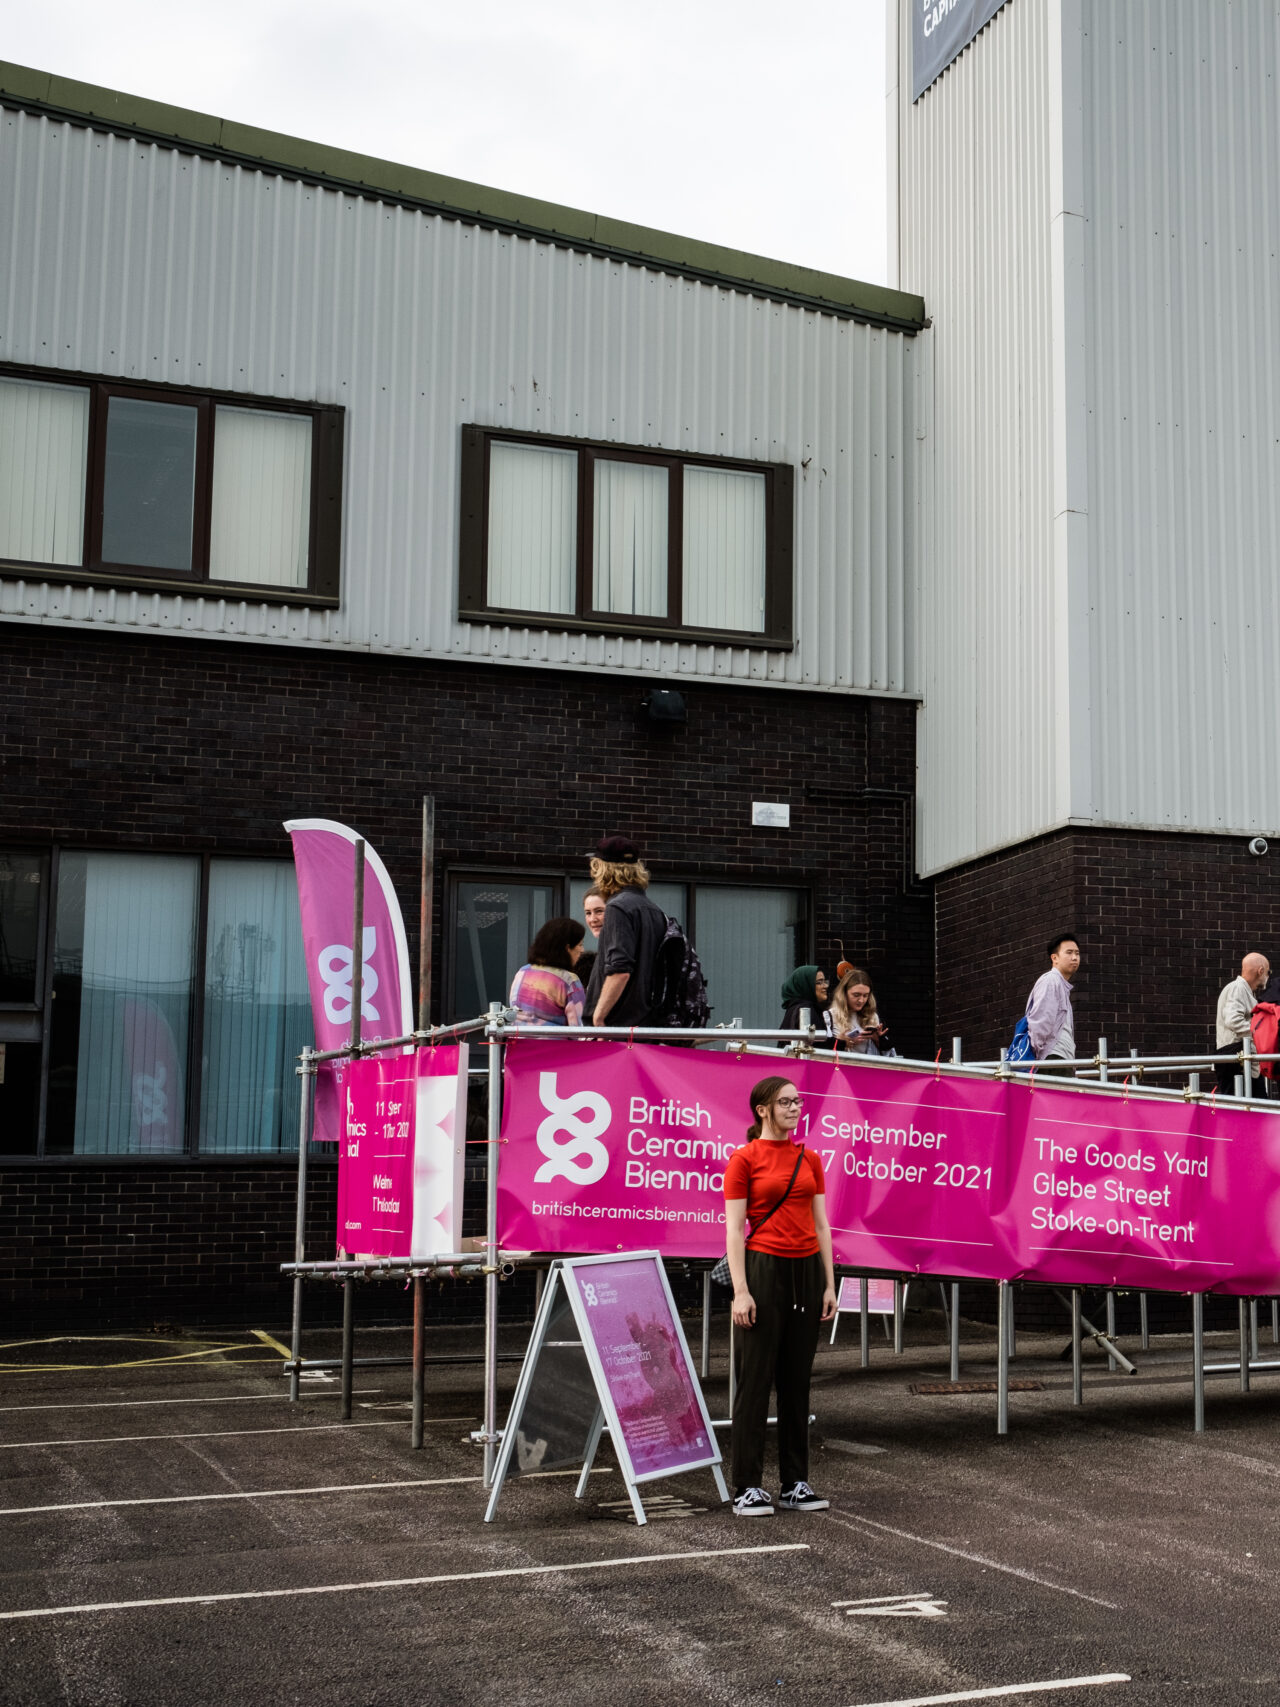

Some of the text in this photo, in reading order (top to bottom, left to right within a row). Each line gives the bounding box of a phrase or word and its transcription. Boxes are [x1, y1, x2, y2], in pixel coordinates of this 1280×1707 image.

[629, 1096, 712, 1129] British
[821, 1114, 948, 1149] September
[843, 1151, 928, 1184] October
[933, 1162, 993, 1190] 2021
[1034, 1137, 1209, 1178] The Goods Yard
[624, 1160, 725, 1192] Biennia
[1033, 1172, 1171, 1208] Glebe Street
[531, 1200, 749, 1226] britishceramicsbiennial.c
[1030, 1206, 1196, 1243] Stoke-on-Trent
[609, 1342, 641, 1355] September
[613, 1355, 637, 1366] October
[638, 1350, 652, 1362] 2021
